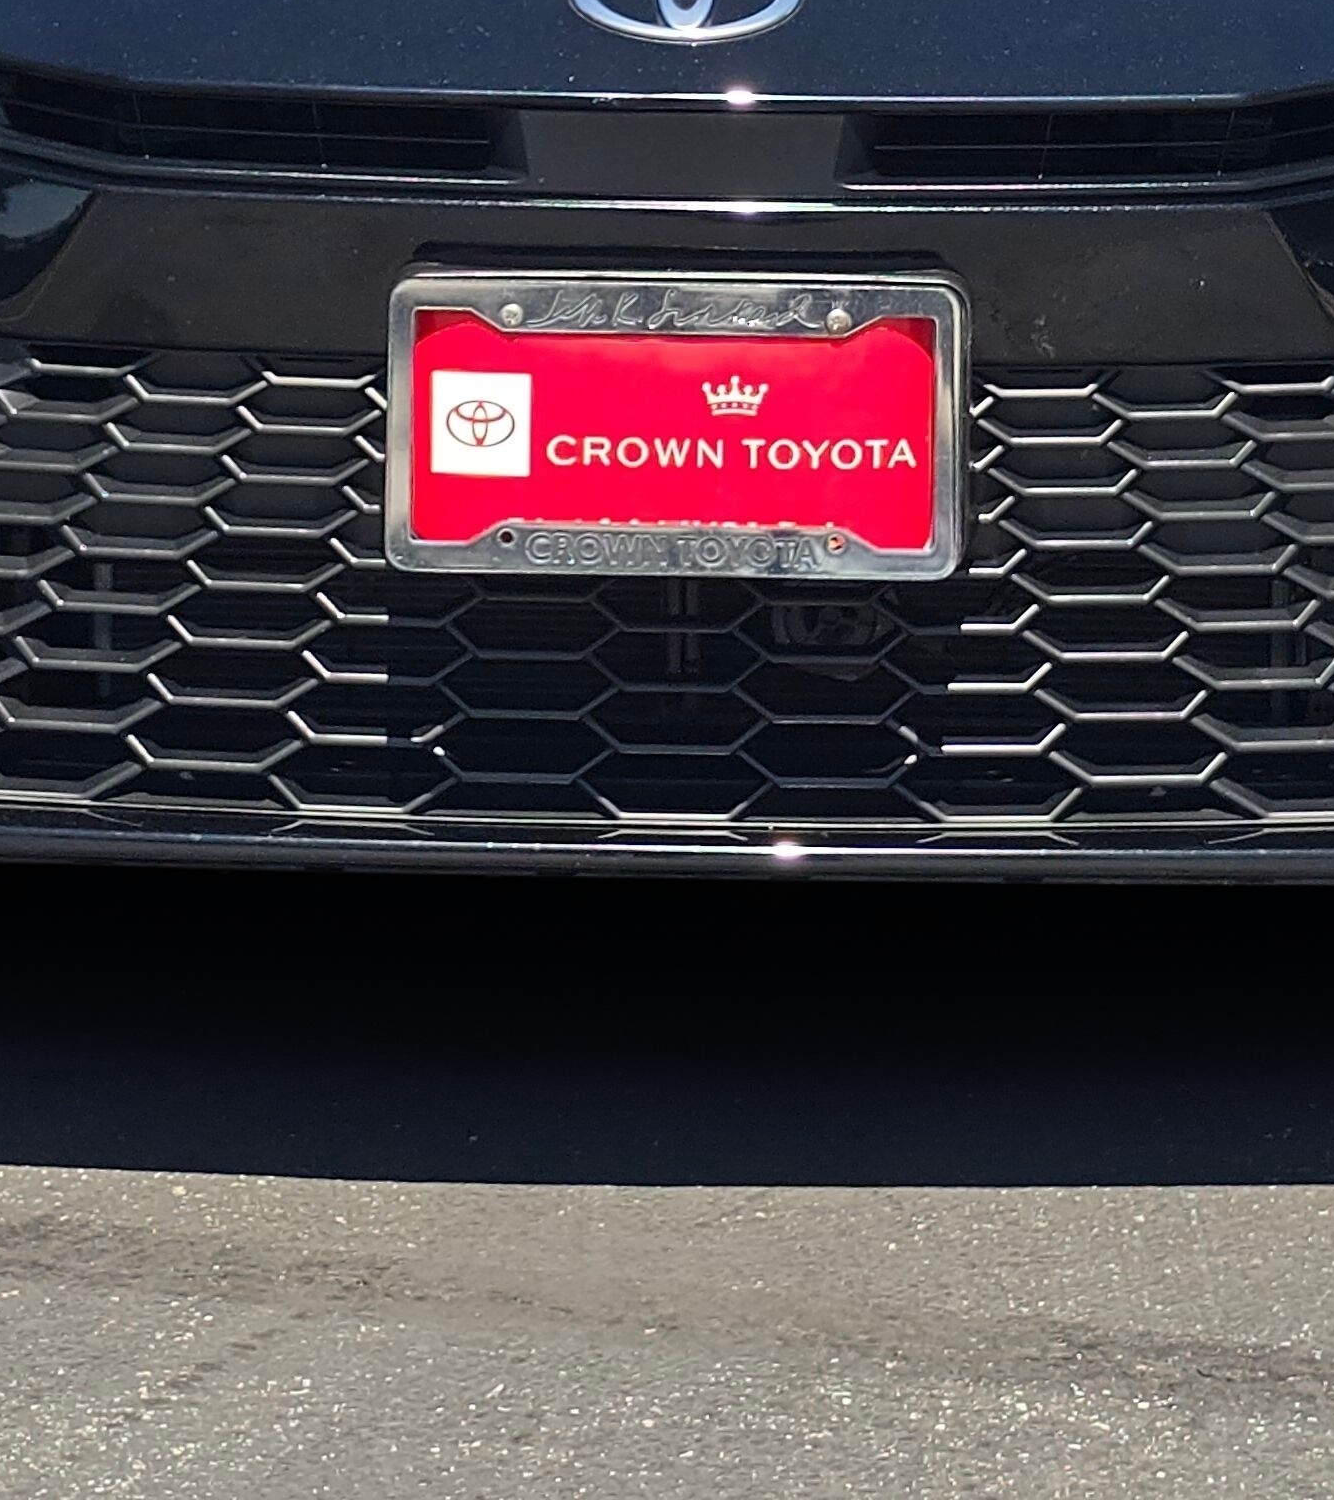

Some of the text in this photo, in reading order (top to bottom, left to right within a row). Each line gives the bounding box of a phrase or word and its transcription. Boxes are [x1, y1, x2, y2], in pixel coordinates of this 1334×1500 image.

[546, 434, 918, 471] CROWN TOYOTA
[524, 530, 819, 570] CROWN TOYOTA
